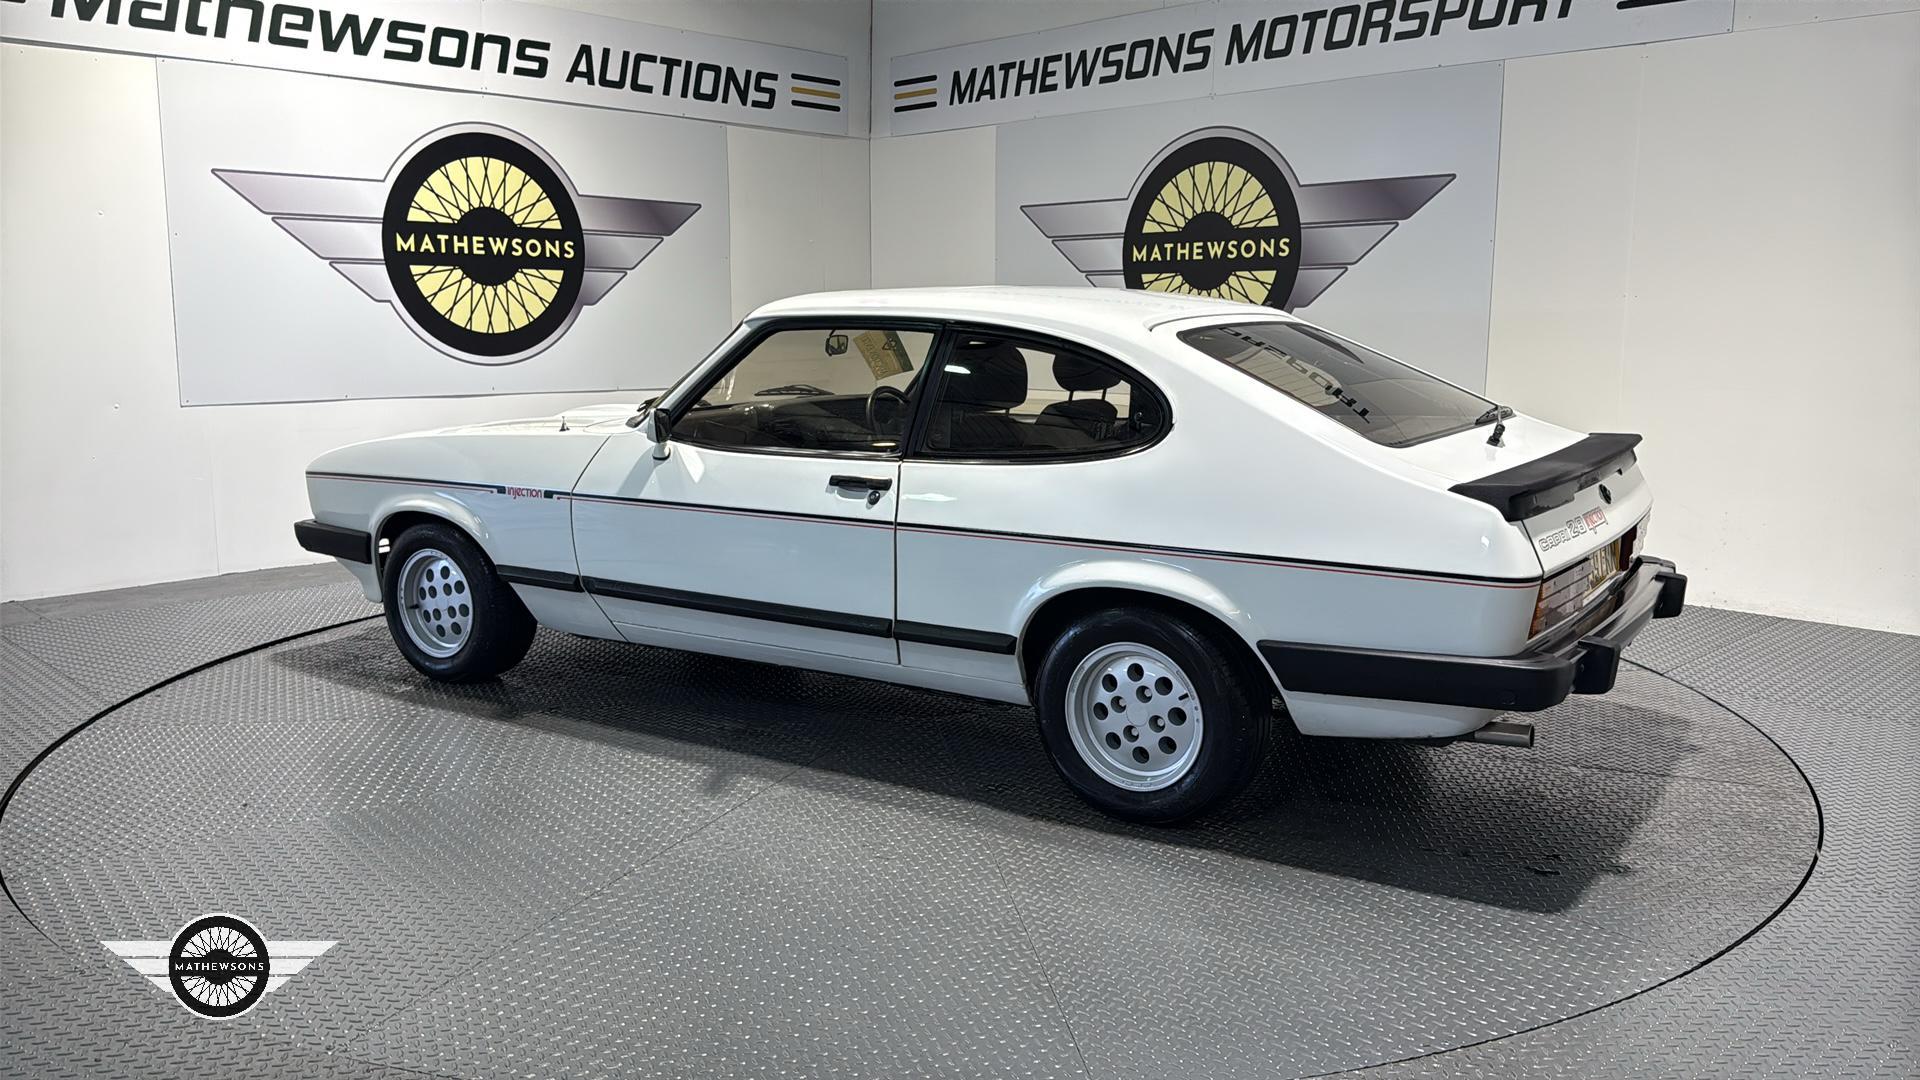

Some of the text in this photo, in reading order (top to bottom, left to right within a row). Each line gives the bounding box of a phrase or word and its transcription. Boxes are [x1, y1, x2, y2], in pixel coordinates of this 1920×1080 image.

[566, 44, 780, 110] AUCTIONS
[949, 28, 1214, 106] MATHEWSONS
[396, 232, 577, 261] MATHEWSONS
[1131, 236, 1291, 263] MATHEWSONS
